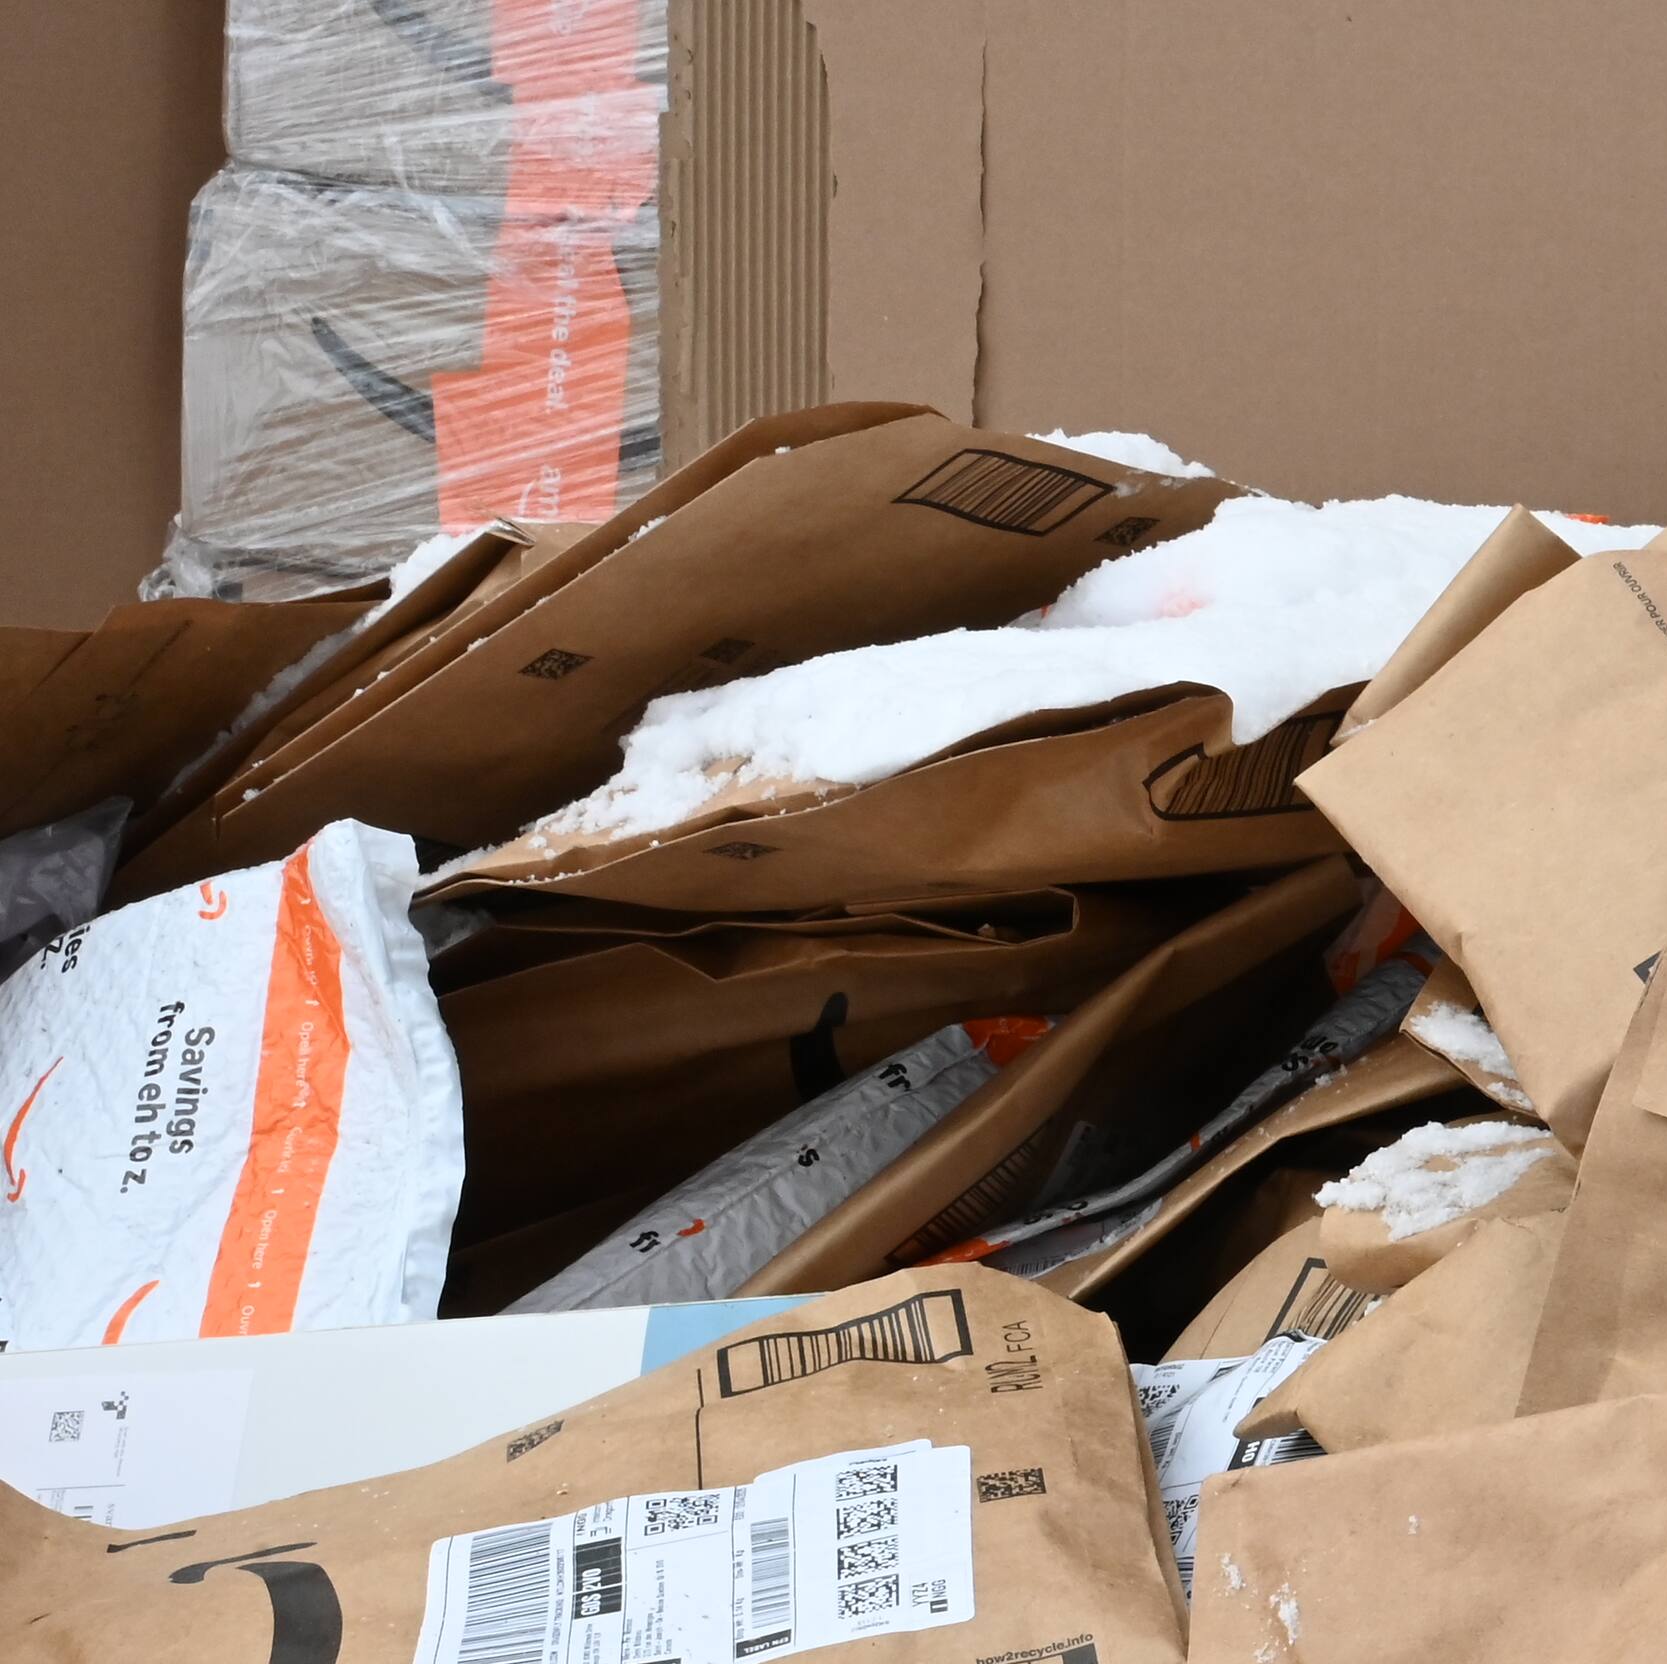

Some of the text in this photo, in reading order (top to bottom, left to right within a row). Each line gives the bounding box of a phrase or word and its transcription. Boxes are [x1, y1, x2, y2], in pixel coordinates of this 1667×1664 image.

[1613, 561, 1642, 594] OUVRIR
[1637, 592, 1660, 619] POUR
[118, 998, 185, 1197] from eh to z.
[162, 1022, 216, 1157] Savings
[256, 1207, 277, 1241] Open
[250, 1240, 270, 1270] here
[1002, 1320, 1034, 1354] FCA
[912, 1582, 929, 1608] YYZ4
